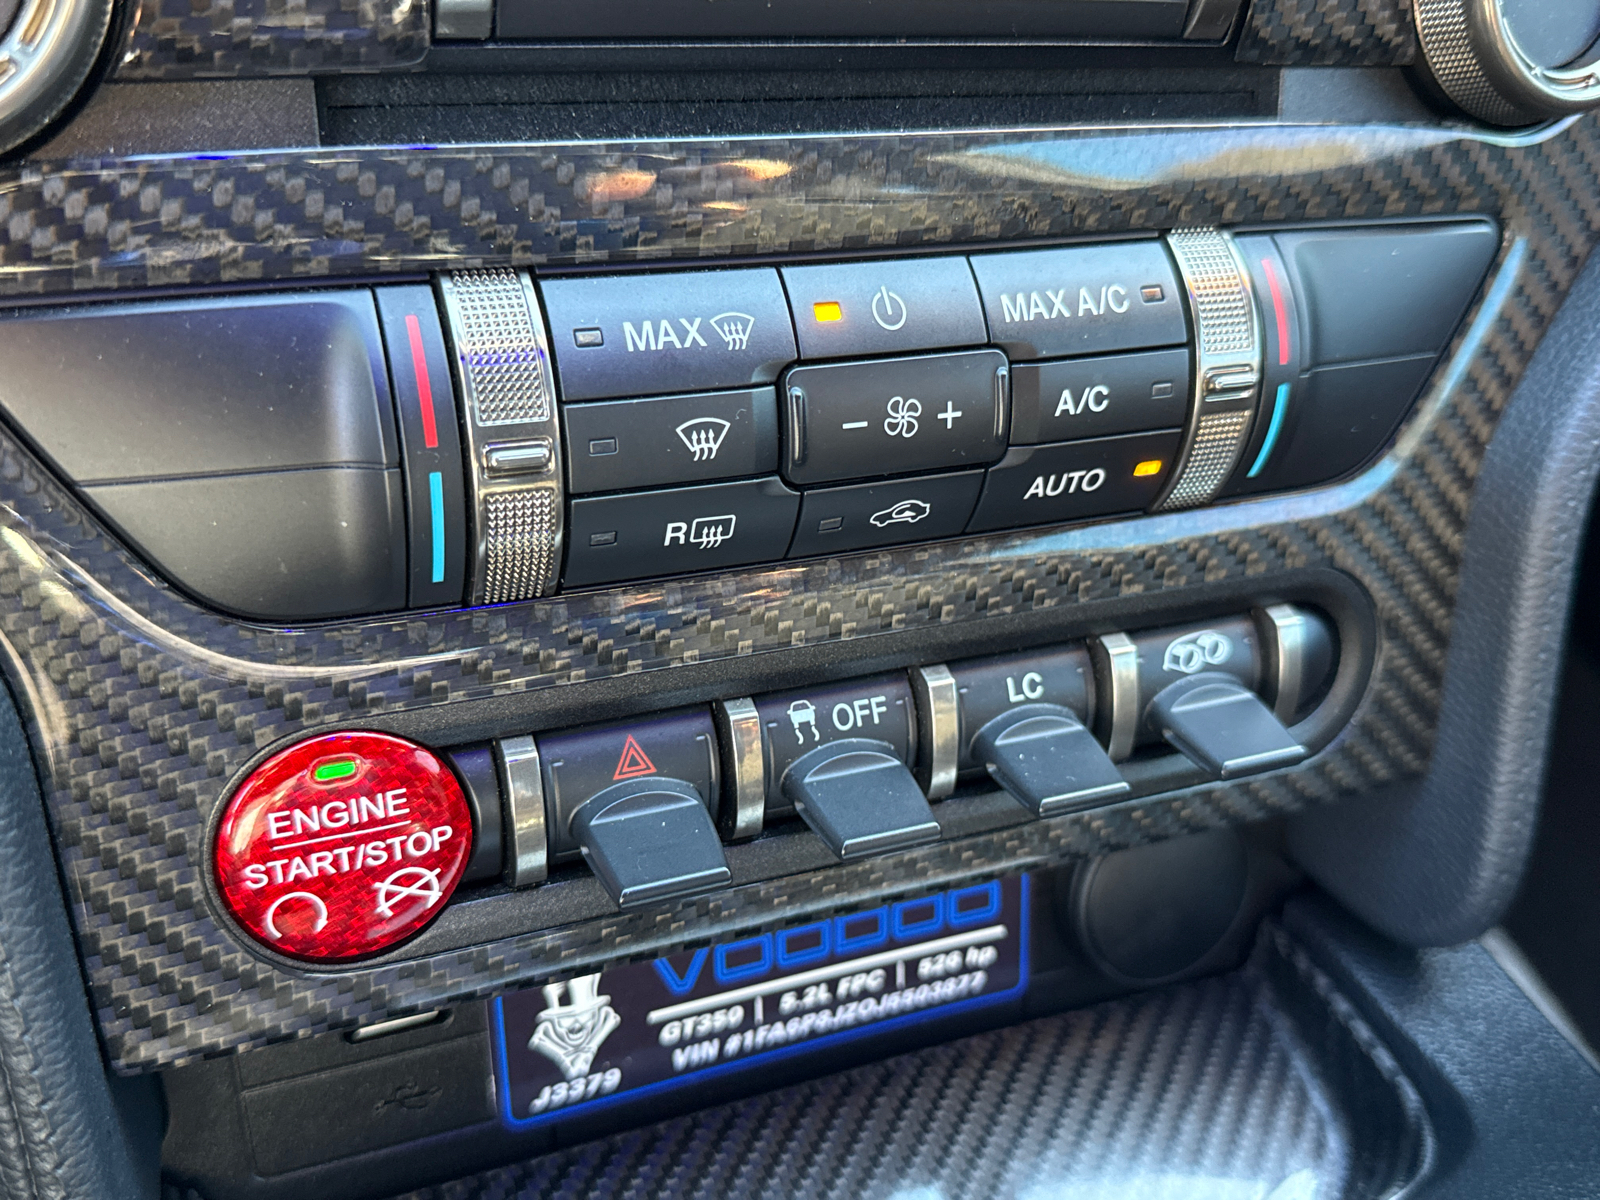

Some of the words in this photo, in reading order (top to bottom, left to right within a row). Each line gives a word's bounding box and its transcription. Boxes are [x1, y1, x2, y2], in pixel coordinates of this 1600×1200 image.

[1000, 287, 1071, 323] MAX
[1077, 283, 1131, 317] A/C
[622, 316, 708, 352] MAX
[1054, 384, 1111, 417] A/C
[1022, 467, 1107, 500] AUTO
[663, 521, 688, 547] R
[1006, 671, 1045, 703] LC
[832, 695, 888, 732] OFF
[267, 787, 411, 840] ENGINE
[244, 824, 454, 889] START/STOP
[658, 1004, 745, 1047] GT350
[778, 982, 833, 1016] 5.2L
[836, 968, 887, 1000] FPC
[917, 950, 964, 981] 526
[671, 1037, 721, 1072] VIN
[528, 1067, 622, 1114] J3379
